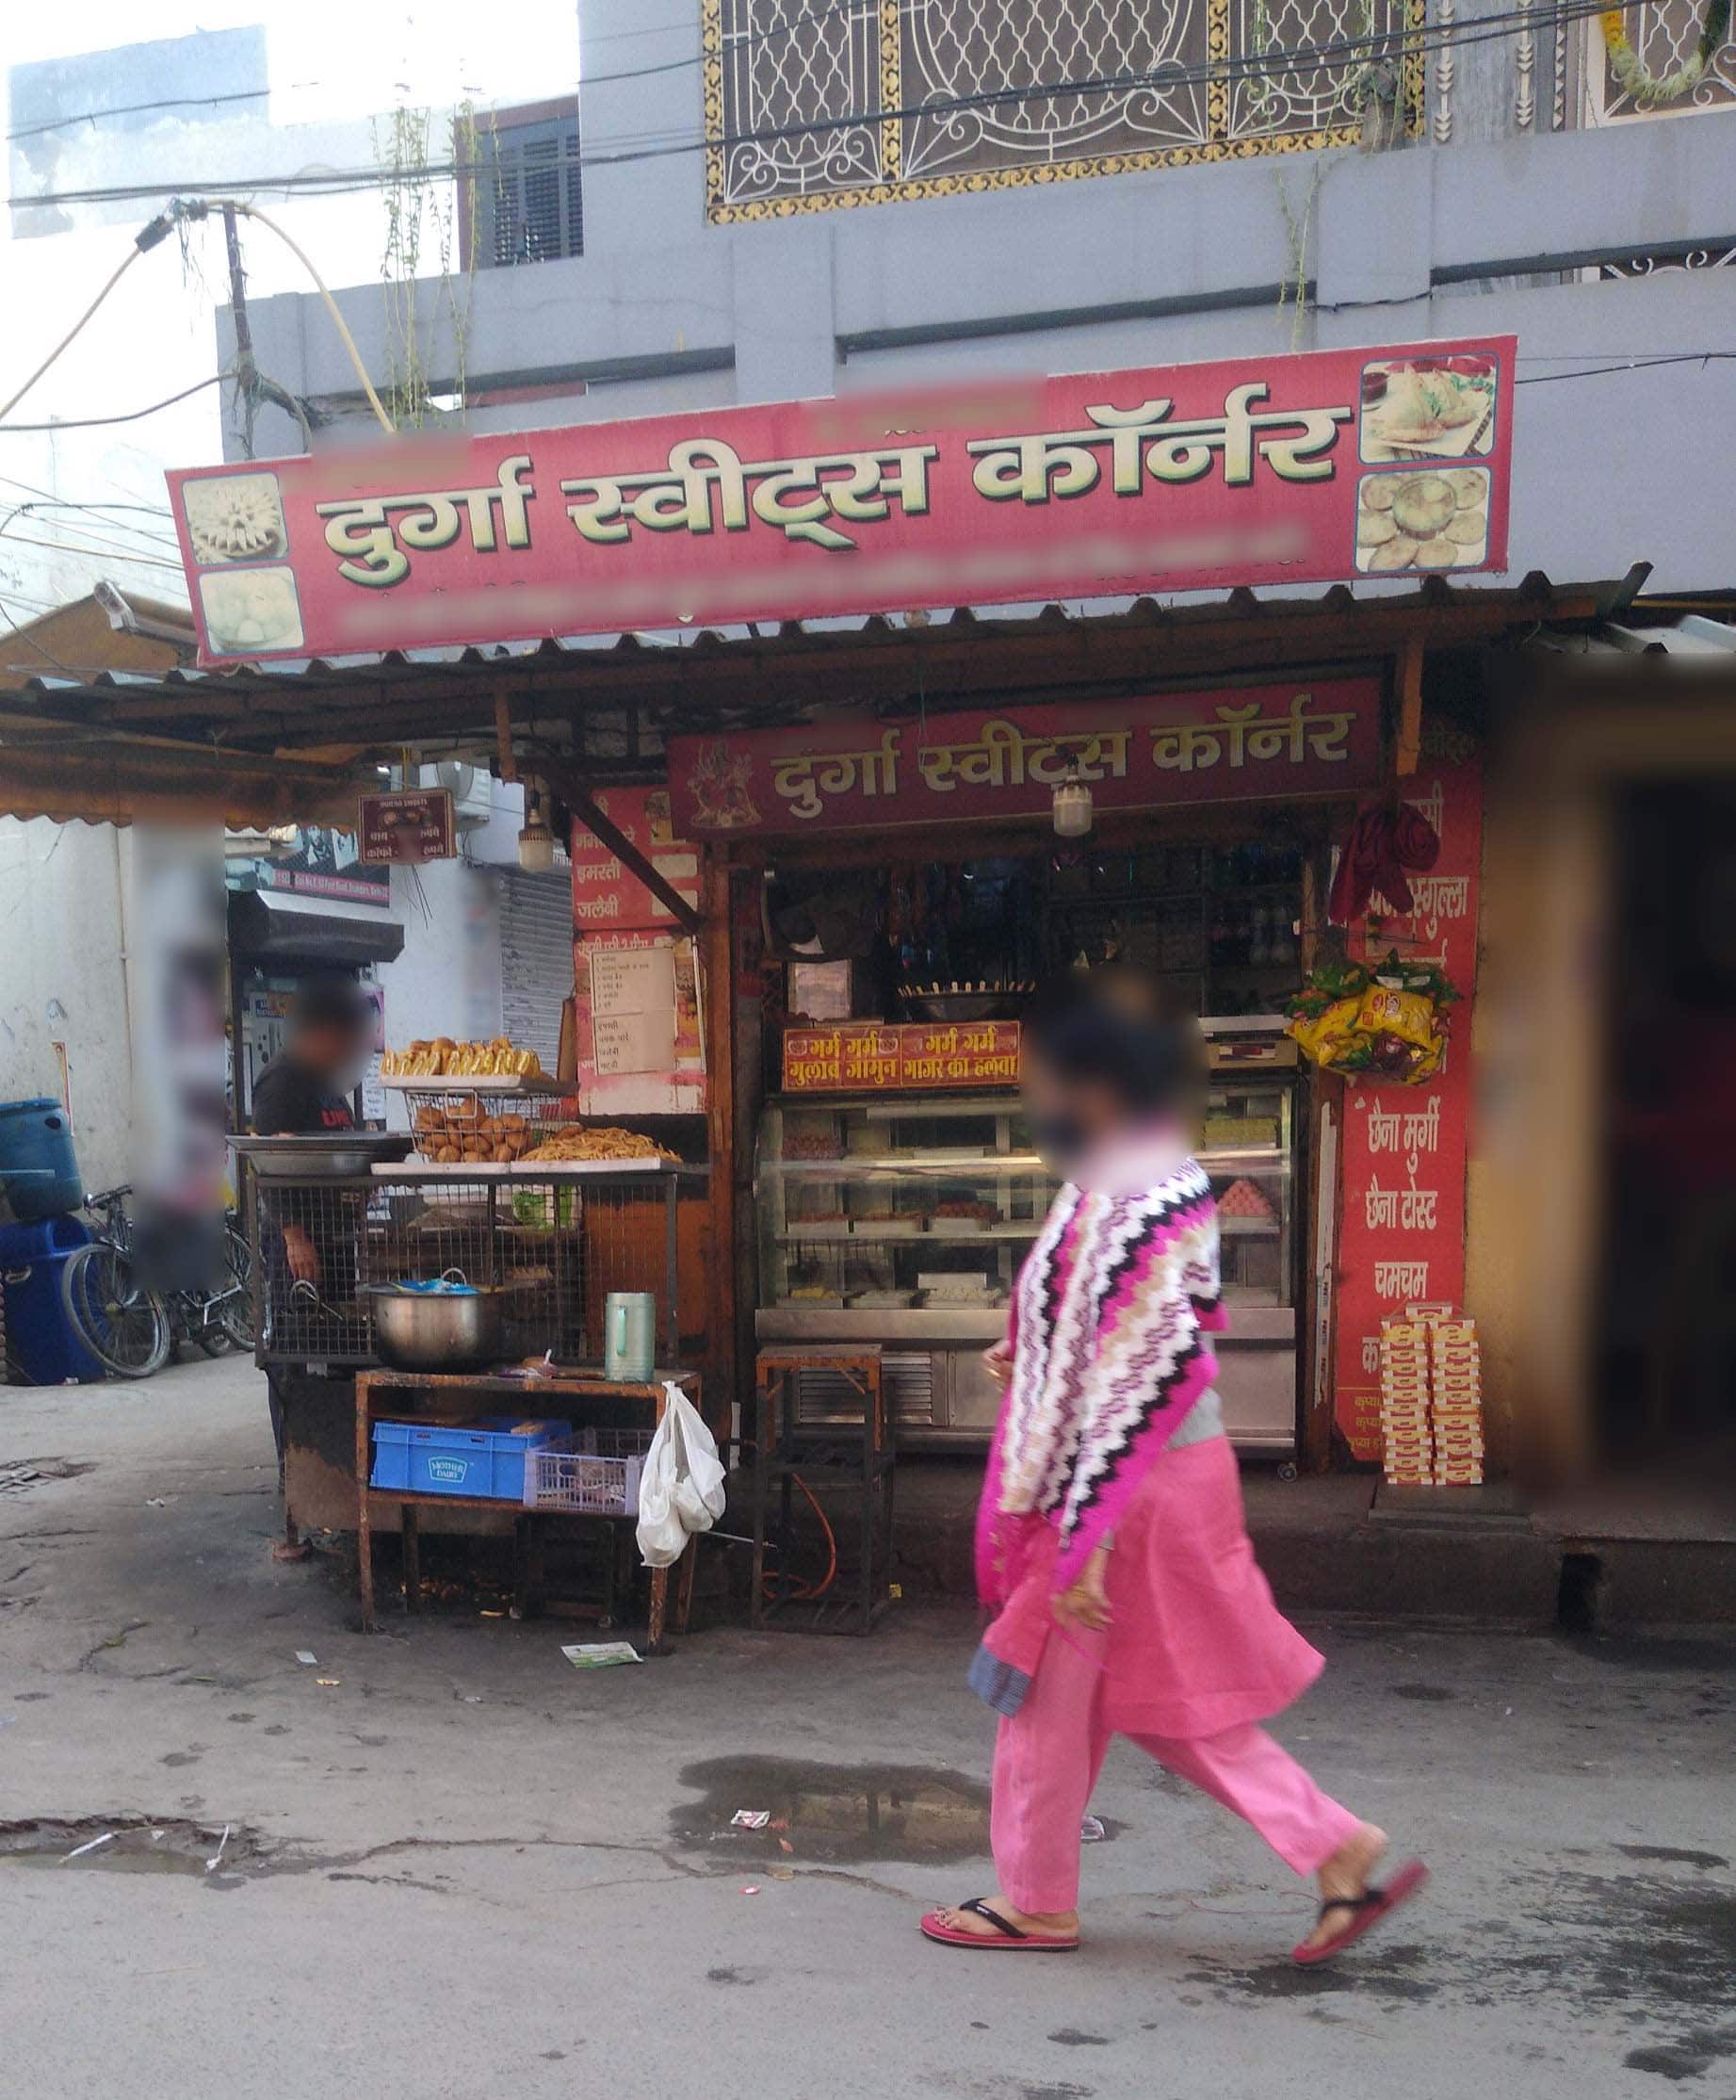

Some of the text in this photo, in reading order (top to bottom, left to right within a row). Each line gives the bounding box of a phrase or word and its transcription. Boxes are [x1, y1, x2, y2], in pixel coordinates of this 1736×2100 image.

[316, 382, 1354, 588] दुर्गा स्वीट्स कॉर्नर
[771, 728, 902, 819] दुर्गा
[1149, 693, 1358, 773] कॉर्नर
[809, 1031, 879, 1058] गर्म गर्म
[925, 1025, 997, 1054] गर्म गर्म
[789, 1058, 898, 1084] गुलाब जामुन
[903, 1055, 1017, 1079] गाजर का हलवा
[1368, 1096, 1401, 1153] छैना
[1365, 1173, 1438, 1230] छैना टोस्ट
[1373, 1261, 1429, 1299] चमचम
[430, 1461, 465, 1473] MOTHER
